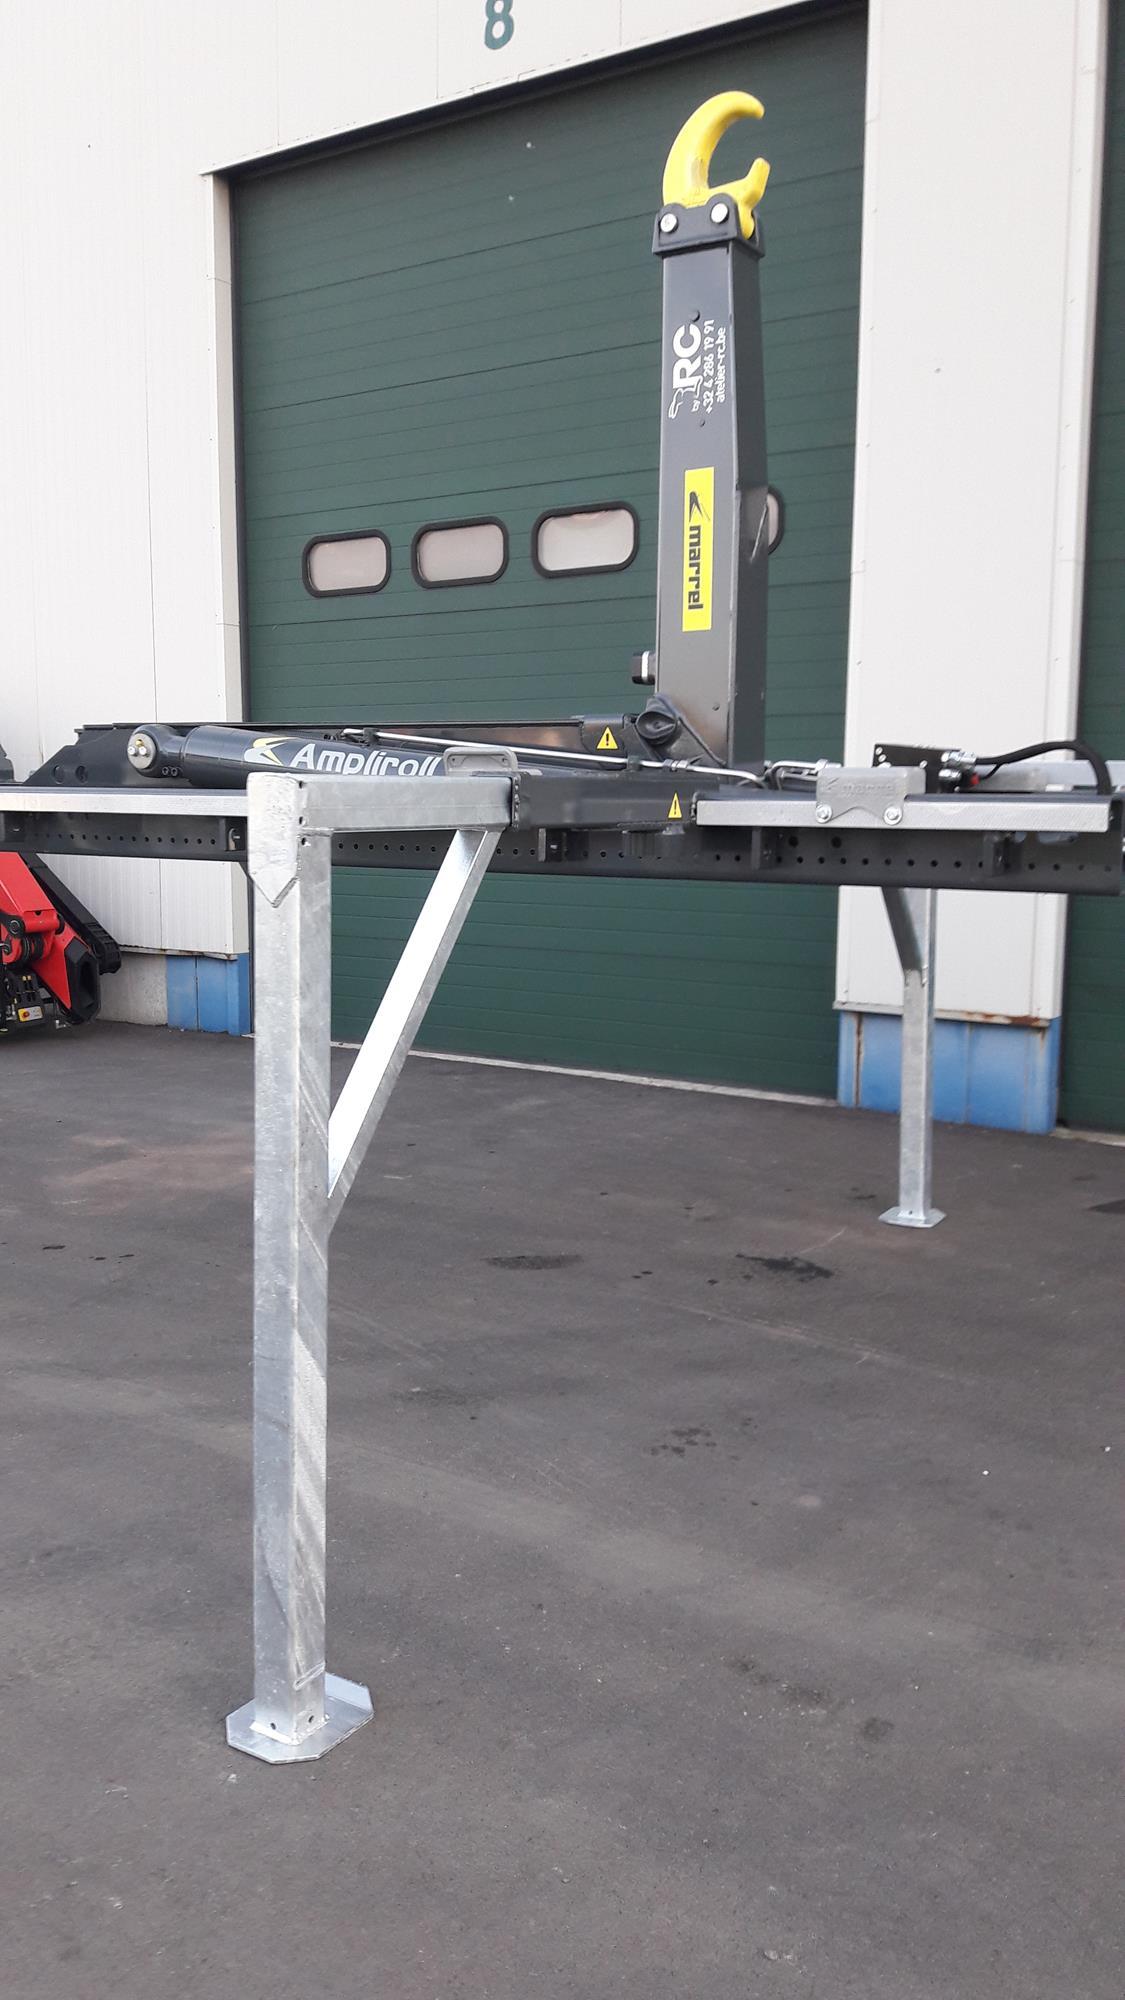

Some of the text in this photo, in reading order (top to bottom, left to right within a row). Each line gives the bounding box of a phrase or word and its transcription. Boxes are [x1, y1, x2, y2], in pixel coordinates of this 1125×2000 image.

[484, 0, 514, 50] 8
[673, 324, 702, 412] by RC
[703, 319, 714, 413] +32 4 286 19 91
[715, 327, 726, 403] atelier-rc.be
[688, 525, 703, 610] marrel
[289, 743, 442, 776] Ampliroll
